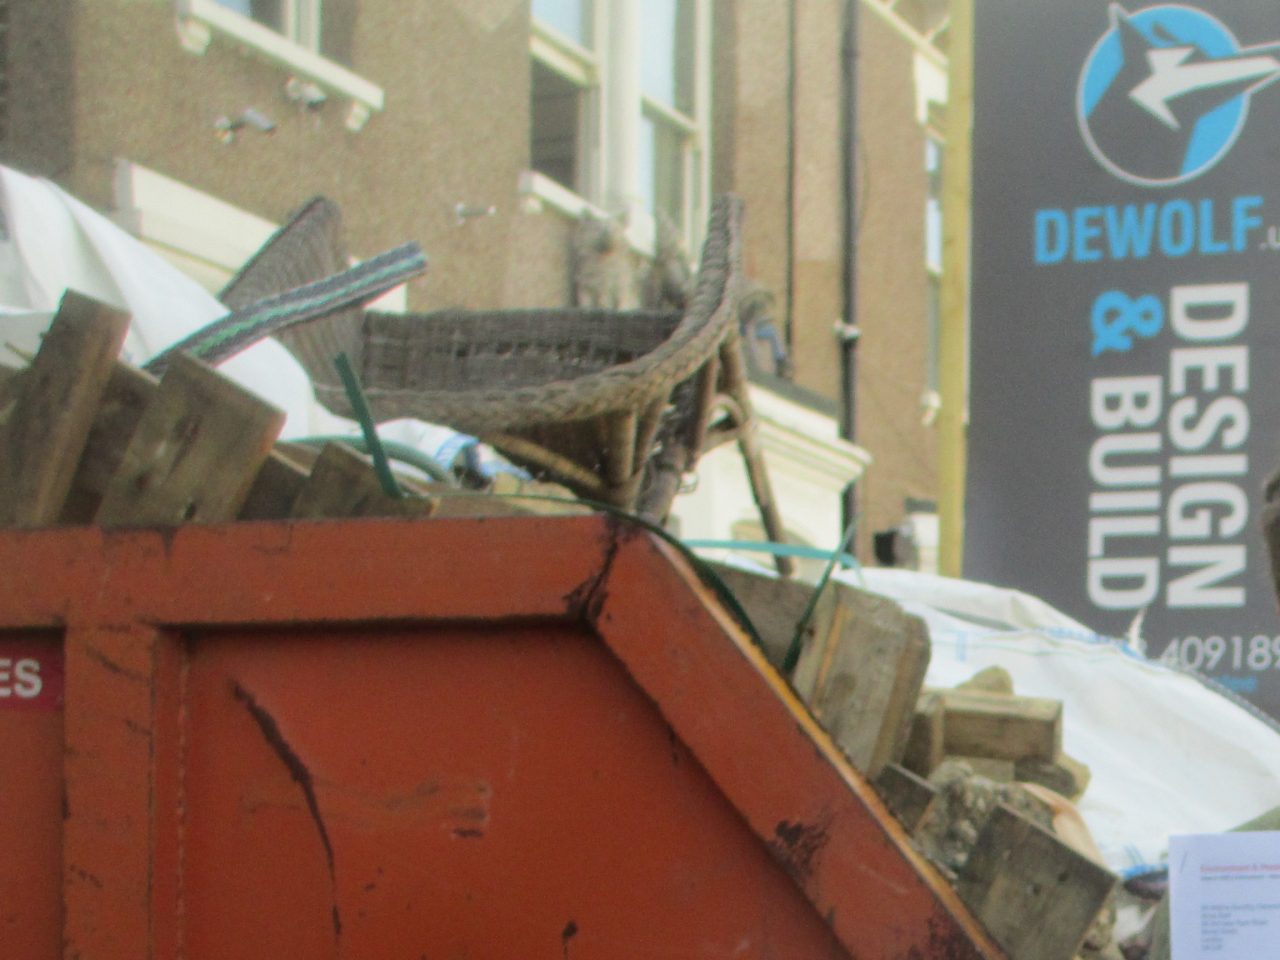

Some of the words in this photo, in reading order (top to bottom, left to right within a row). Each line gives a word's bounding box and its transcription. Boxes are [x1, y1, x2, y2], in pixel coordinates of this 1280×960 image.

[1090, 289, 1165, 357] &
[1087, 375, 1164, 610] BUILD
[1166, 282, 1249, 608] DESIGN
